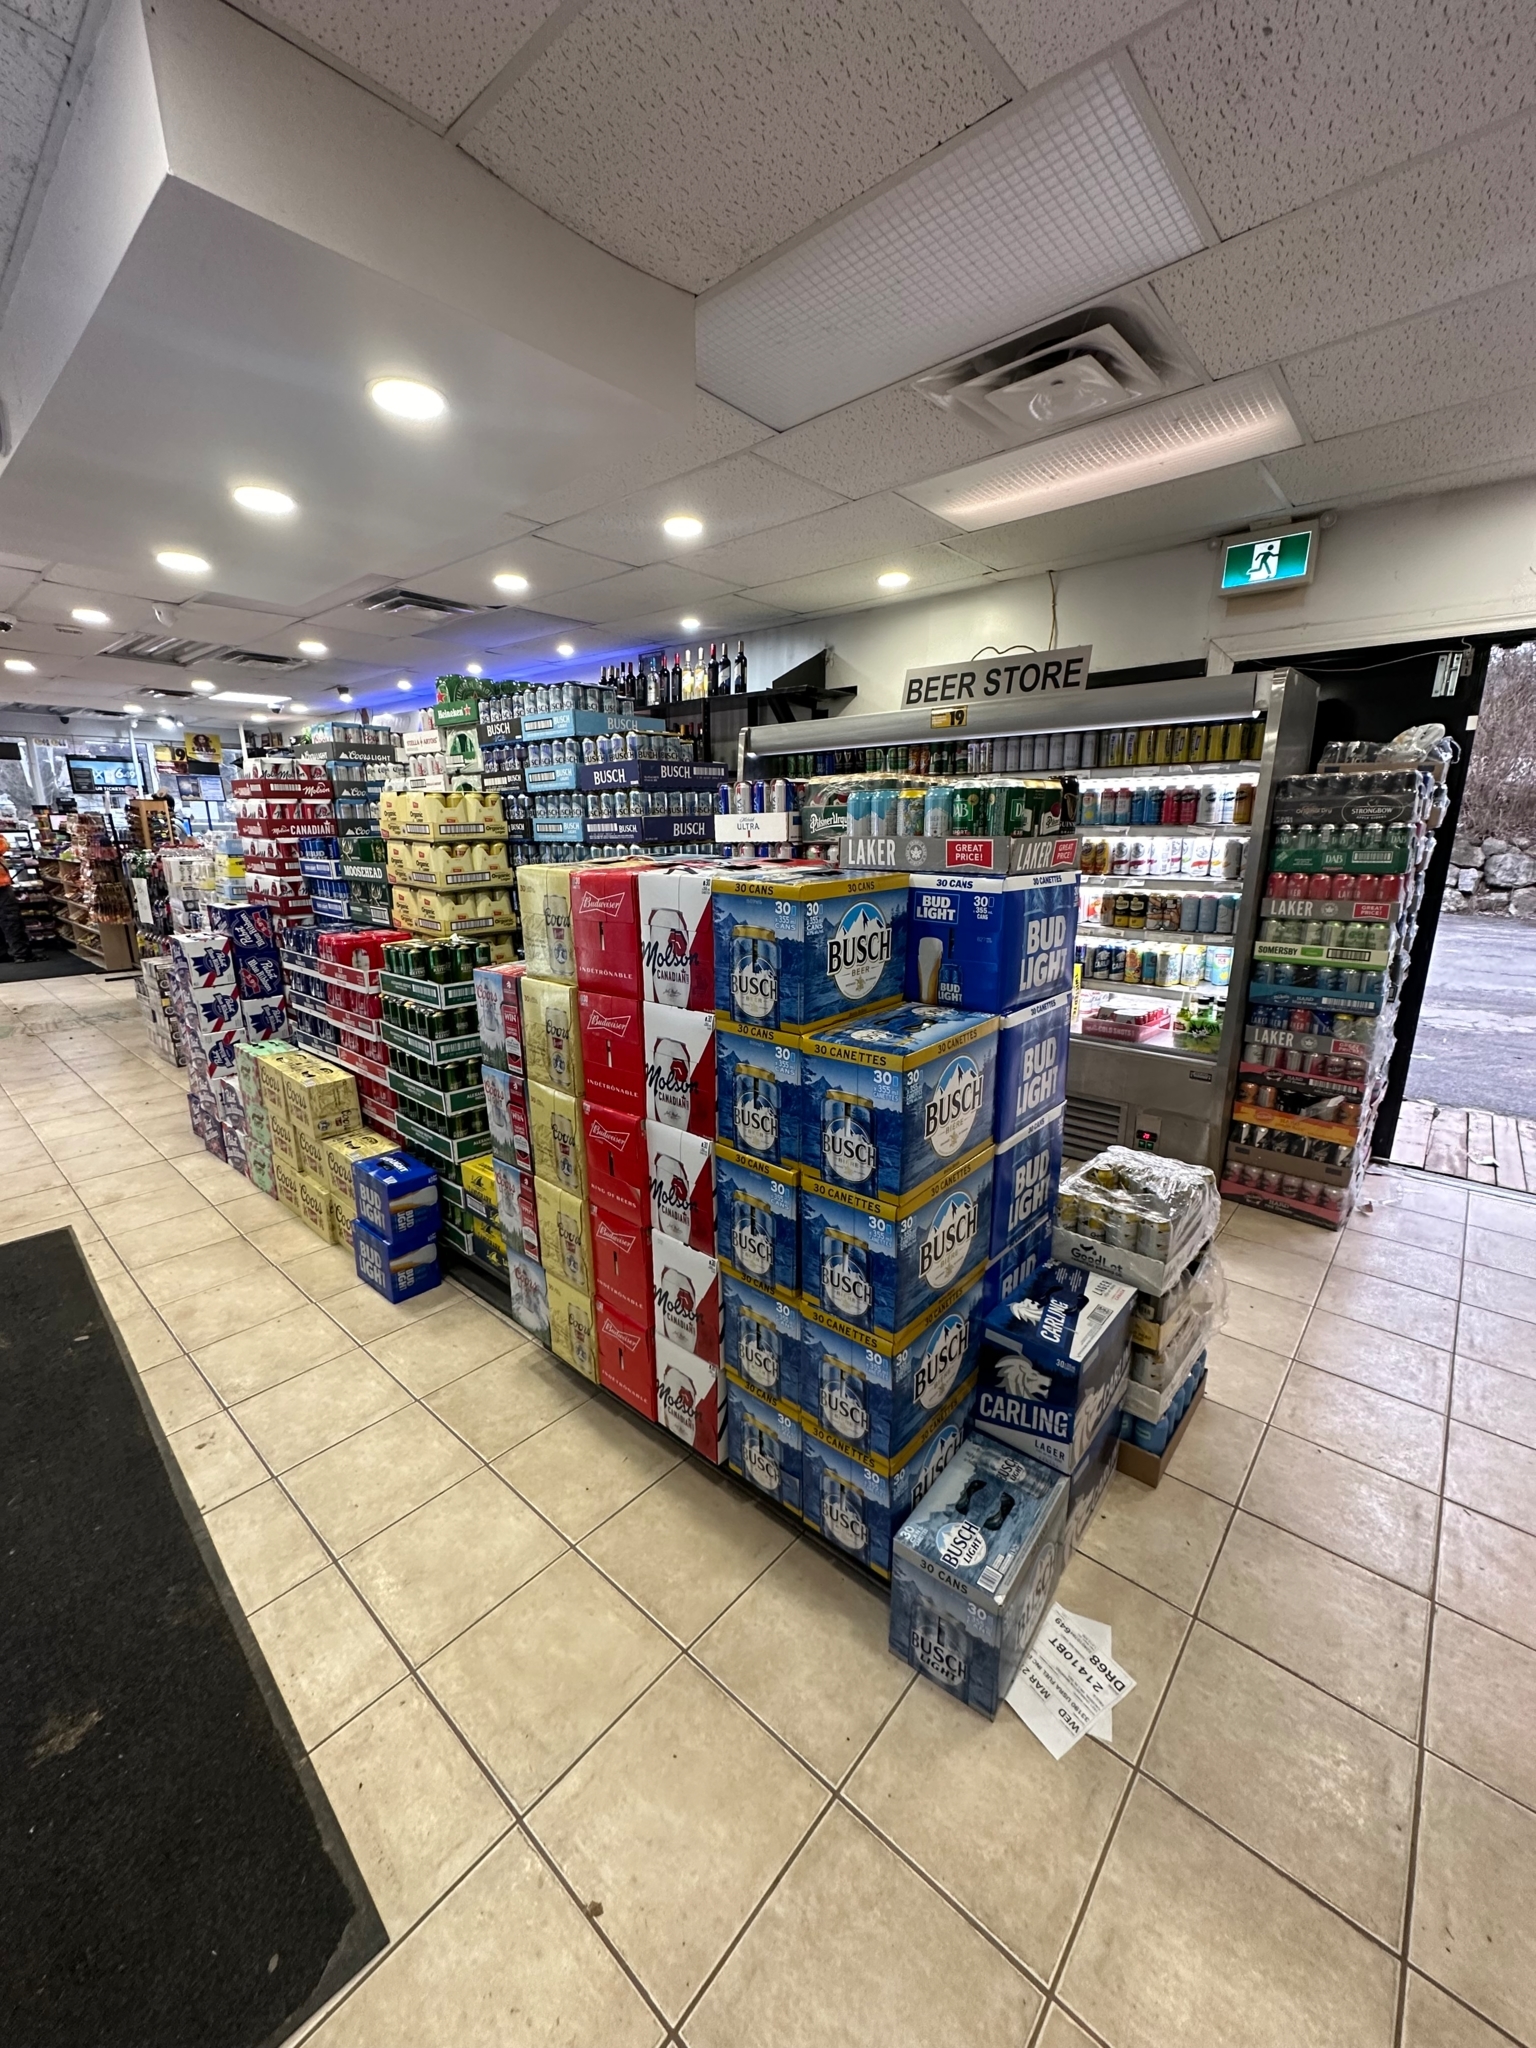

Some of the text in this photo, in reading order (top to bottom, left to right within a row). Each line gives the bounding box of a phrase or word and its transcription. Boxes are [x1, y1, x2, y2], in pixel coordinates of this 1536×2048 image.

[906, 657, 1084, 705] BEER STORE
[438, 706, 464, 719] Heineken
[553, 714, 570, 724] BUSCH
[950, 709, 965, 726] 19
[487, 722, 511, 736] BUSCH
[607, 717, 638, 731] BUSCH
[172, 748, 186, 761] 19
[555, 768, 572, 777] BUSCH
[593, 768, 627, 786] BUSCH
[660, 765, 692, 779] BUSCH
[1351, 807, 1394, 815] STRONGBOW
[290, 825, 331, 836] CANADIAN
[563, 822, 580, 831] BUSCH
[618, 824, 638, 834] BUSCH
[673, 822, 706, 837] BUSCH
[736, 822, 760, 831] ULTRA
[848, 838, 896, 866] LAKER
[955, 843, 984, 853] GREAT
[955, 852, 984, 861] PRICE!
[1016, 841, 1052, 871] LAKER
[1056, 850, 1073, 860] PRICE!
[1058, 842, 1074, 853] GREAT
[1325, 854, 1343, 864] DAB
[343, 865, 383, 879] MOOSEHEAD
[735, 883, 774, 895] 30 CANS
[857, 881, 875, 892] CANS
[936, 879, 973, 889] 30 CANS
[583, 896, 621, 910] Budweiser
[775, 901, 791, 914] 30
[806, 902, 819, 916] 30
[922, 895, 951, 909] BUD
[973, 896, 988, 907] 30
[1271, 900, 1313, 917] LAKER
[916, 906, 957, 921] LIGHT
[775, 923, 796, 931] CANS
[1026, 915, 1067, 955] BUD
[642, 940, 700, 977] Molson
[827, 927, 892, 976] BUSCH
[1258, 945, 1298, 956] SOMERSBY
[579, 966, 633, 980] INDÉTRÔNABLE
[657, 970, 687, 983] CANADIAN
[851, 965, 871, 977] BEER
[1019, 948, 1068, 992] LIGHT
[731, 973, 778, 1000] BUSCH
[940, 982, 961, 993] BUD
[504, 1012, 517, 1023] WIN
[590, 1013, 627, 1032] Budweiser
[737, 1024, 774, 1040] 30 CANS
[947, 1029, 977, 1050] CANETTES
[1254, 1028, 1294, 1047] LAKER
[775, 1046, 791, 1061] 30
[814, 1044, 887, 1066] 30 CANETTES
[1023, 1036, 1057, 1081] BUD
[645, 1063, 699, 1097] Molson
[874, 1069, 892, 1085] 30
[907, 1069, 919, 1085] 30
[286, 1080, 307, 1109] Coors
[658, 1092, 687, 1110] CANADIAN
[1016, 1065, 1059, 1118] LIGHT
[925, 1074, 984, 1140] BUSCH
[734, 1106, 778, 1138] BUSCH
[592, 1124, 626, 1146] Budweiser
[300, 1132, 322, 1161] Coors
[823, 1132, 876, 1169] BUSCH
[735, 1154, 770, 1174] 30 CANS
[1015, 1149, 1051, 1198] BUD
[276, 1163, 297, 1192] Coors
[649, 1175, 698, 1213] Molson
[771, 1181, 785, 1194] 30
[300, 1183, 322, 1214] Coors
[359, 1182, 382, 1213] BUD
[814, 1184, 881, 1214] 30 CANETTES
[1007, 1179, 1051, 1232] LIGHT
[361, 1203, 386, 1231] LIGHT
[406, 1210, 415, 1229] BUD
[869, 1216, 886, 1232] 30
[732, 1229, 773, 1265] BUSCH
[918, 1204, 979, 1279] BUSCH
[359, 1240, 382, 1270] BUD
[1071, 1247, 1123, 1272] GoodLot
[361, 1261, 386, 1289] LIGHT
[821, 1265, 872, 1306] BUSCH
[1092, 1280, 1113, 1296] LAGER
[653, 1285, 705, 1325] Molson
[776, 1301, 790, 1316] 30
[813, 1311, 878, 1348] 30 CANETTES
[1040, 1297, 1069, 1344] CARLING
[738, 1342, 779, 1381] BUSCH
[866, 1349, 882, 1365] 30
[914, 1322, 970, 1404] BUSCH
[756, 1386, 778, 1407] CANS
[820, 1387, 869, 1432] BUSCH
[979, 1392, 1070, 1438] CARLING
[777, 1413, 792, 1427] 30
[813, 1427, 875, 1467] 30 CANETTES
[1034, 1440, 1066, 1461] LAGER
[743, 1446, 780, 1486] BUSCH
[864, 1468, 880, 1483] 30
[822, 1499, 868, 1544] BUSCH
[900, 1525, 914, 1540] 30
[941, 1520, 980, 1568] BUSCH
[964, 1537, 983, 1564] LIGHT
[920, 1560, 968, 1594] 30 CANS
[967, 1601, 987, 1620] 30
[911, 1629, 967, 1679] BUSCH
[920, 1655, 958, 1682] LIGHT
[1032, 1659, 1043, 1671] INC
[1048, 1637, 1104, 1693] 21410BT
[1089, 1654, 1126, 1692] DR68
[1042, 1670, 1056, 1686] FUEL
[1029, 1675, 1081, 1734] WED MAR
